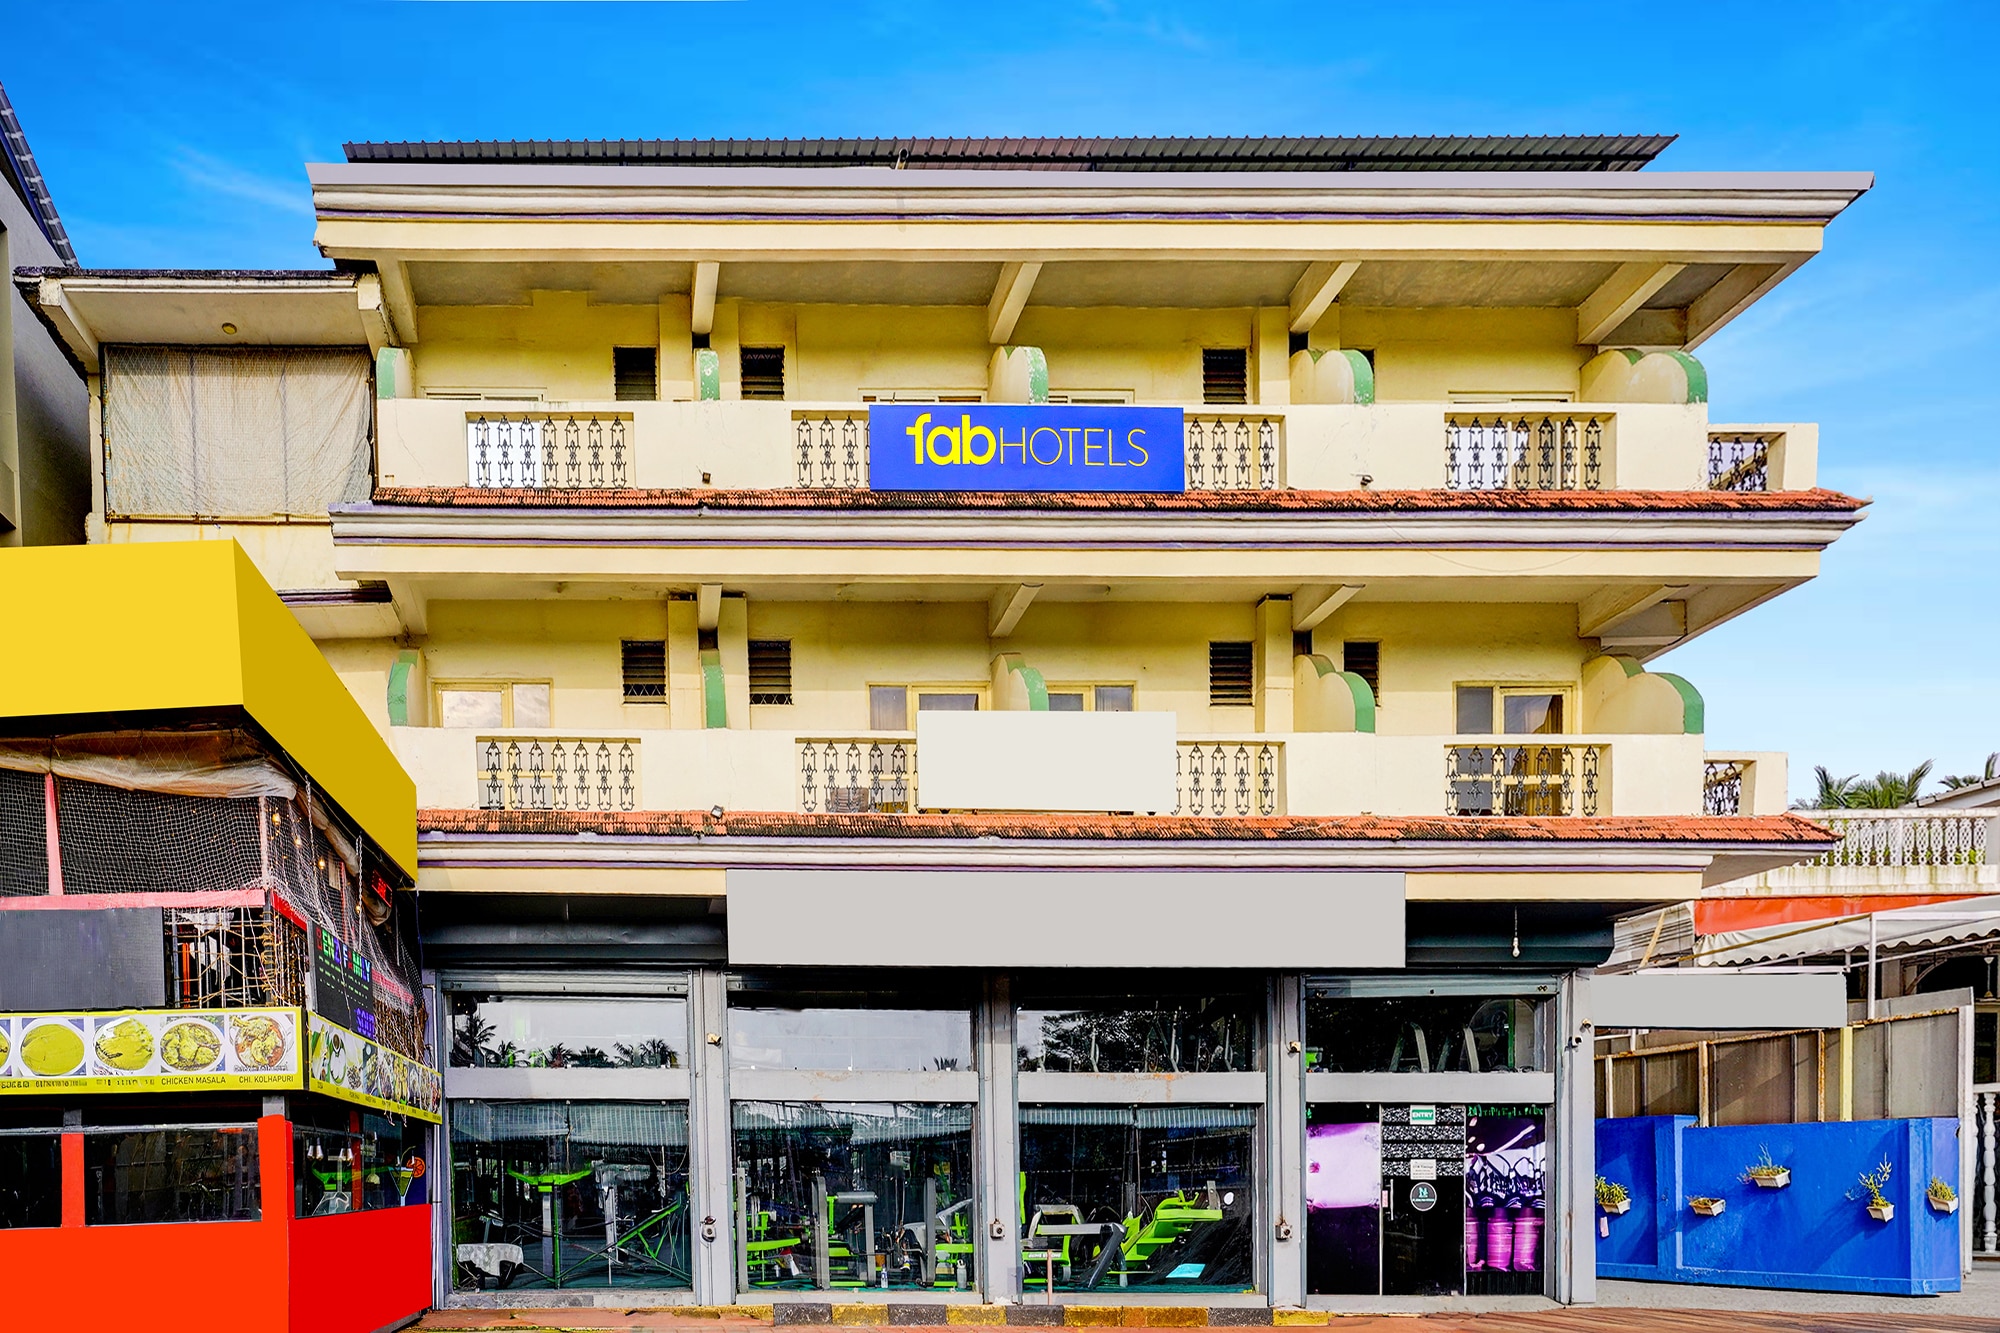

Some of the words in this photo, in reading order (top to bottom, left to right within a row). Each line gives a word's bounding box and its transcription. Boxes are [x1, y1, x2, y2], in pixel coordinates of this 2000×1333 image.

[906, 412, 1149, 467] fabHOTELS
[161, 1077, 194, 1085] CHICKEN
[196, 1076, 226, 1084] MASALA
[254, 1075, 293, 1083] KOLHAPURI
